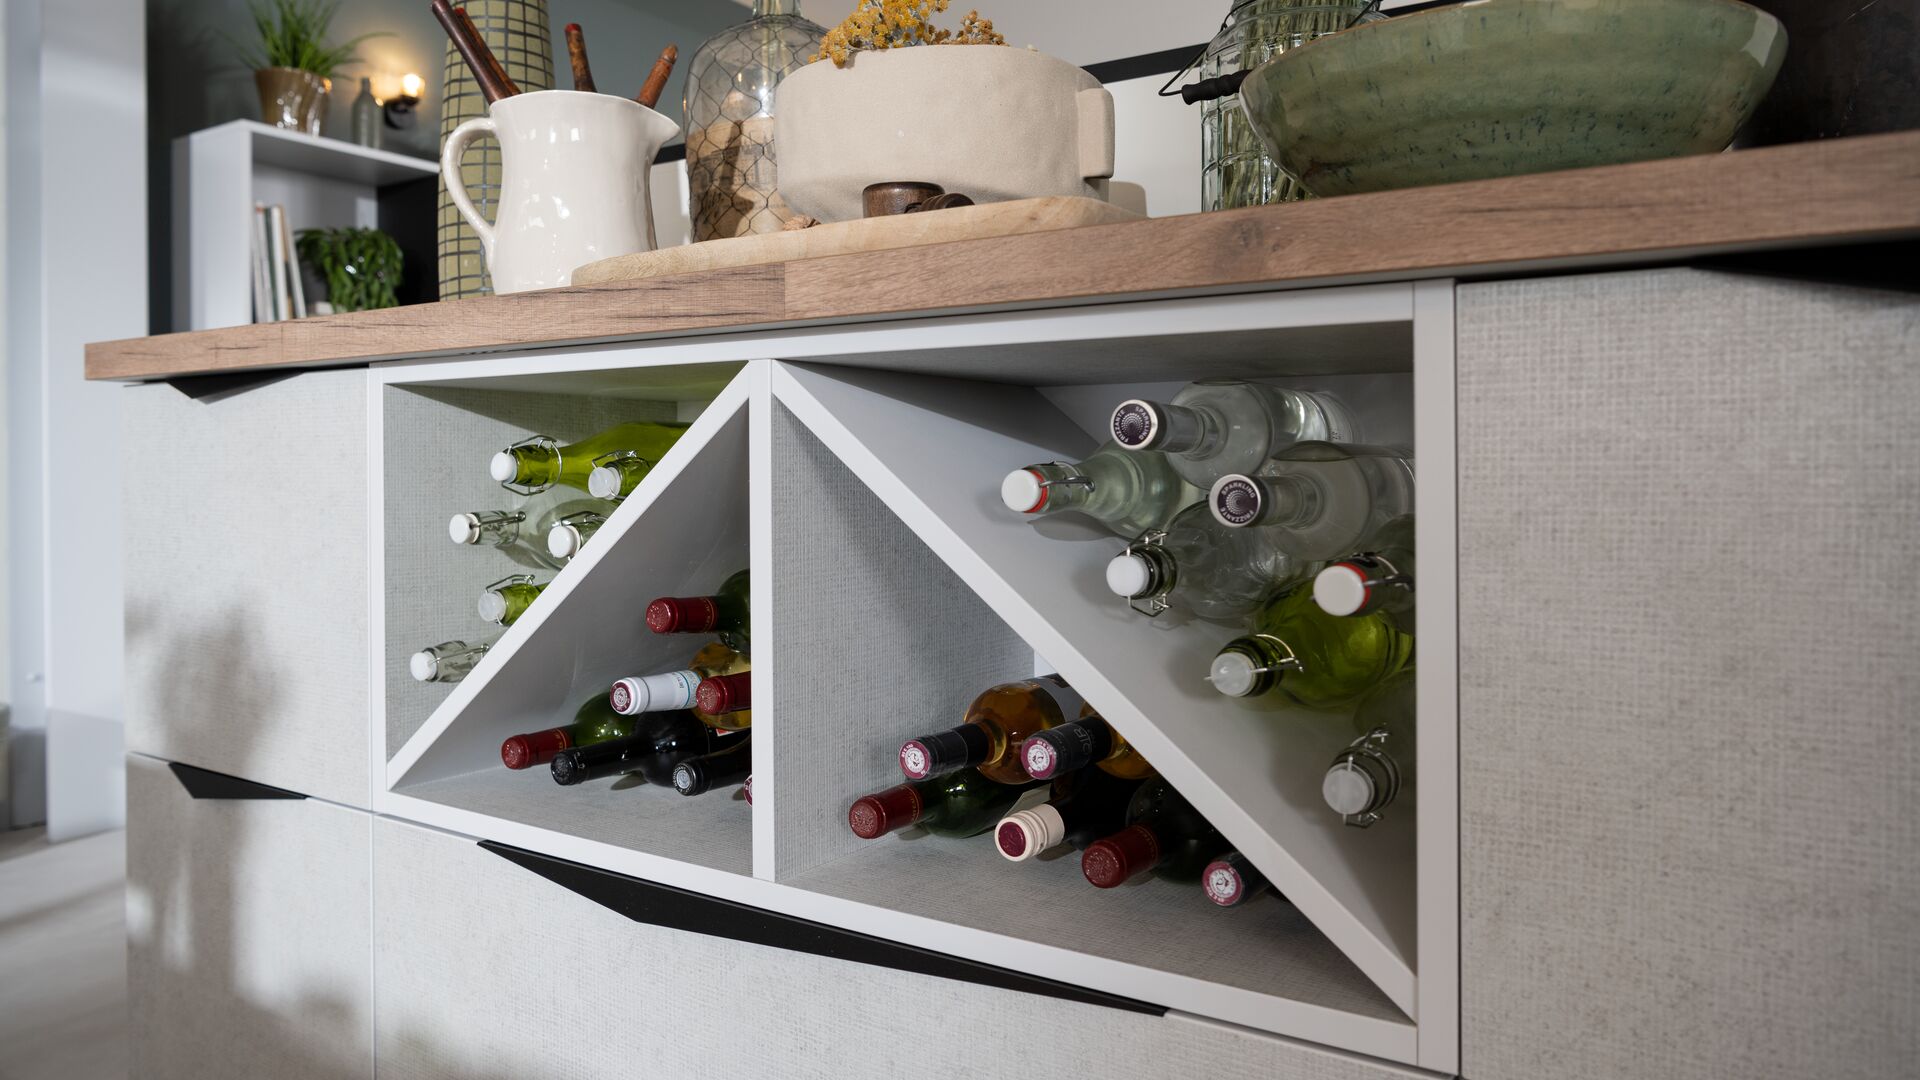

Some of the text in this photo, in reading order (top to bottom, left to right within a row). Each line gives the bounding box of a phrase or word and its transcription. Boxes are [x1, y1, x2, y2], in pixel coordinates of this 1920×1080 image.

[1114, 409, 1129, 443] FRIZZANTE
[1135, 406, 1150, 441] SPARKLING
[1221, 481, 1256, 499] SPARKLING
[1220, 506, 1254, 523] FRIZZANTE
